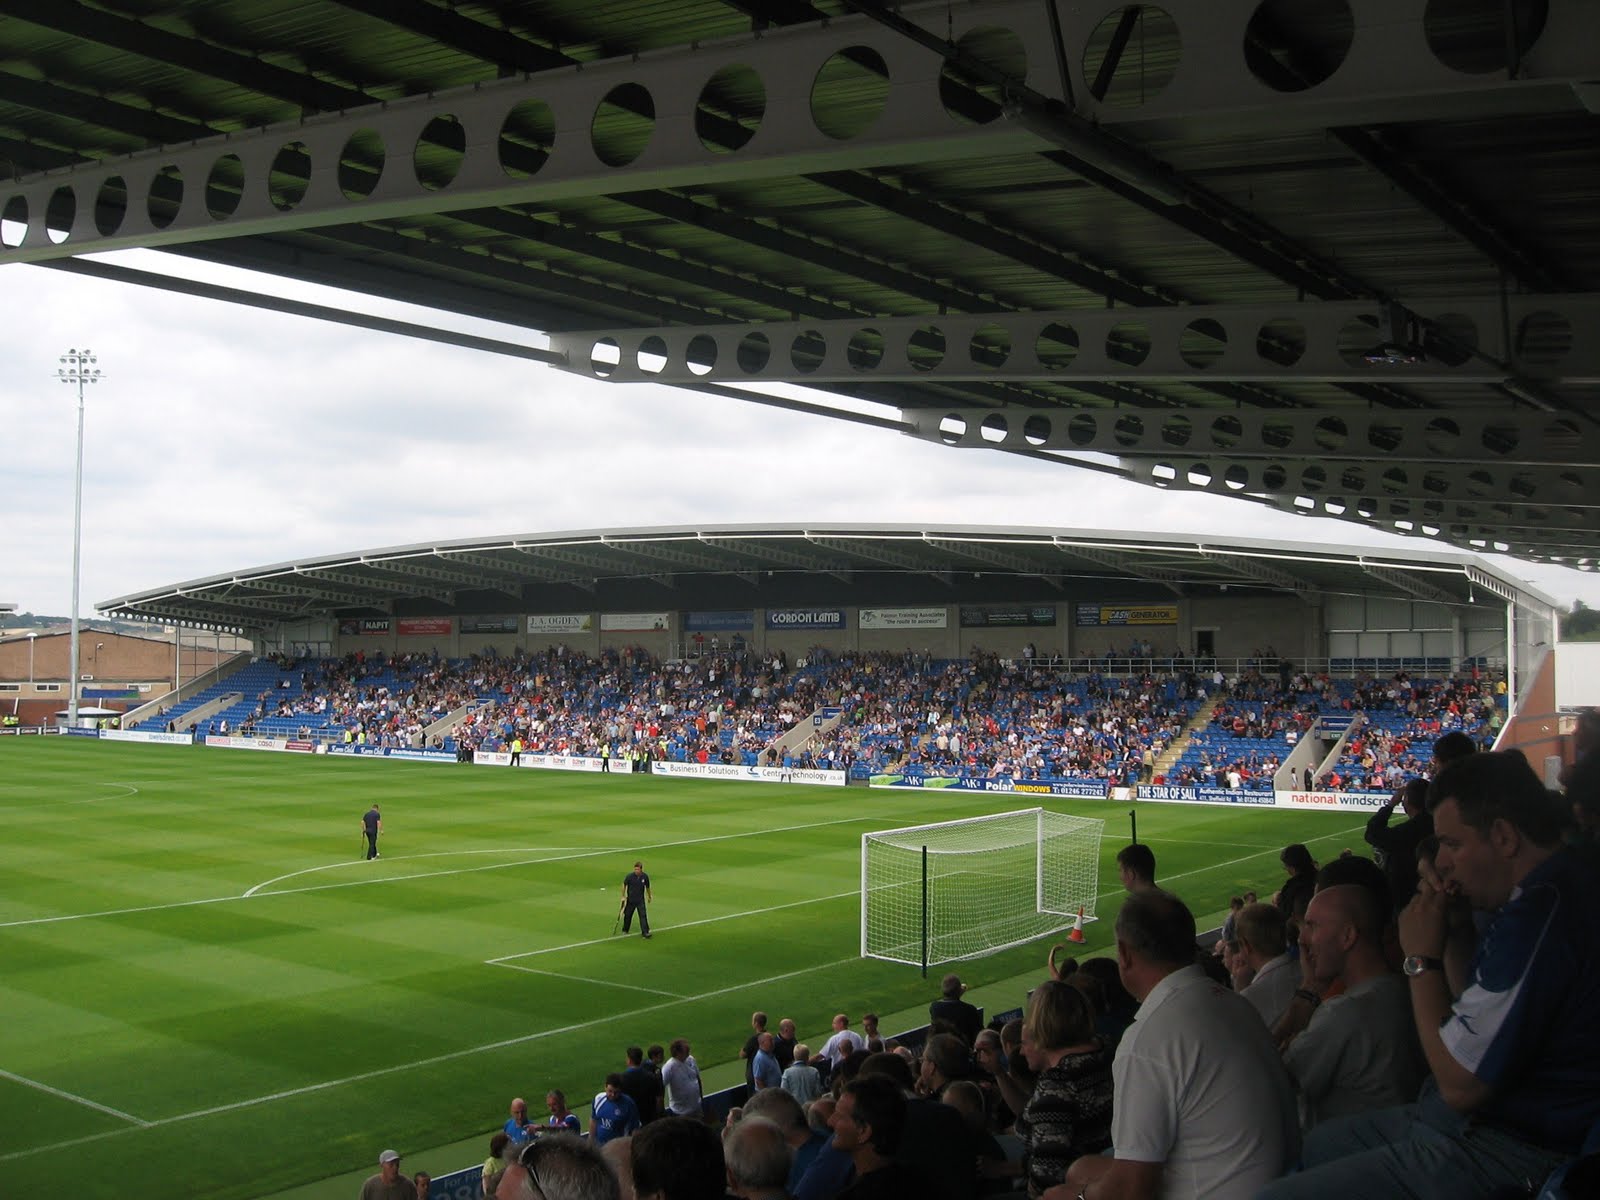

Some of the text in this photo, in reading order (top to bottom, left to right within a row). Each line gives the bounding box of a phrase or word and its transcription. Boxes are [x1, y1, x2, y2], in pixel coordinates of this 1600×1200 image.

[772, 612, 840, 624] GORDON LAMB
[1109, 611, 1129, 619] CASH
[365, 621, 389, 629] NAPIT
[530, 616, 580, 625] J. A. OGDEN
[670, 764, 739, 775] Business IT Solutions
[908, 776, 919, 785] VK
[965, 778, 977, 788] VK
[986, 779, 1013, 791] Polar
[1014, 784, 1051, 793] WINDOWS
[1081, 788, 1104, 796] 277242
[1138, 786, 1197, 800] THE STAR OF SALL
[1291, 793, 1337, 804] national
[444, 1169, 482, 1189] For FR
